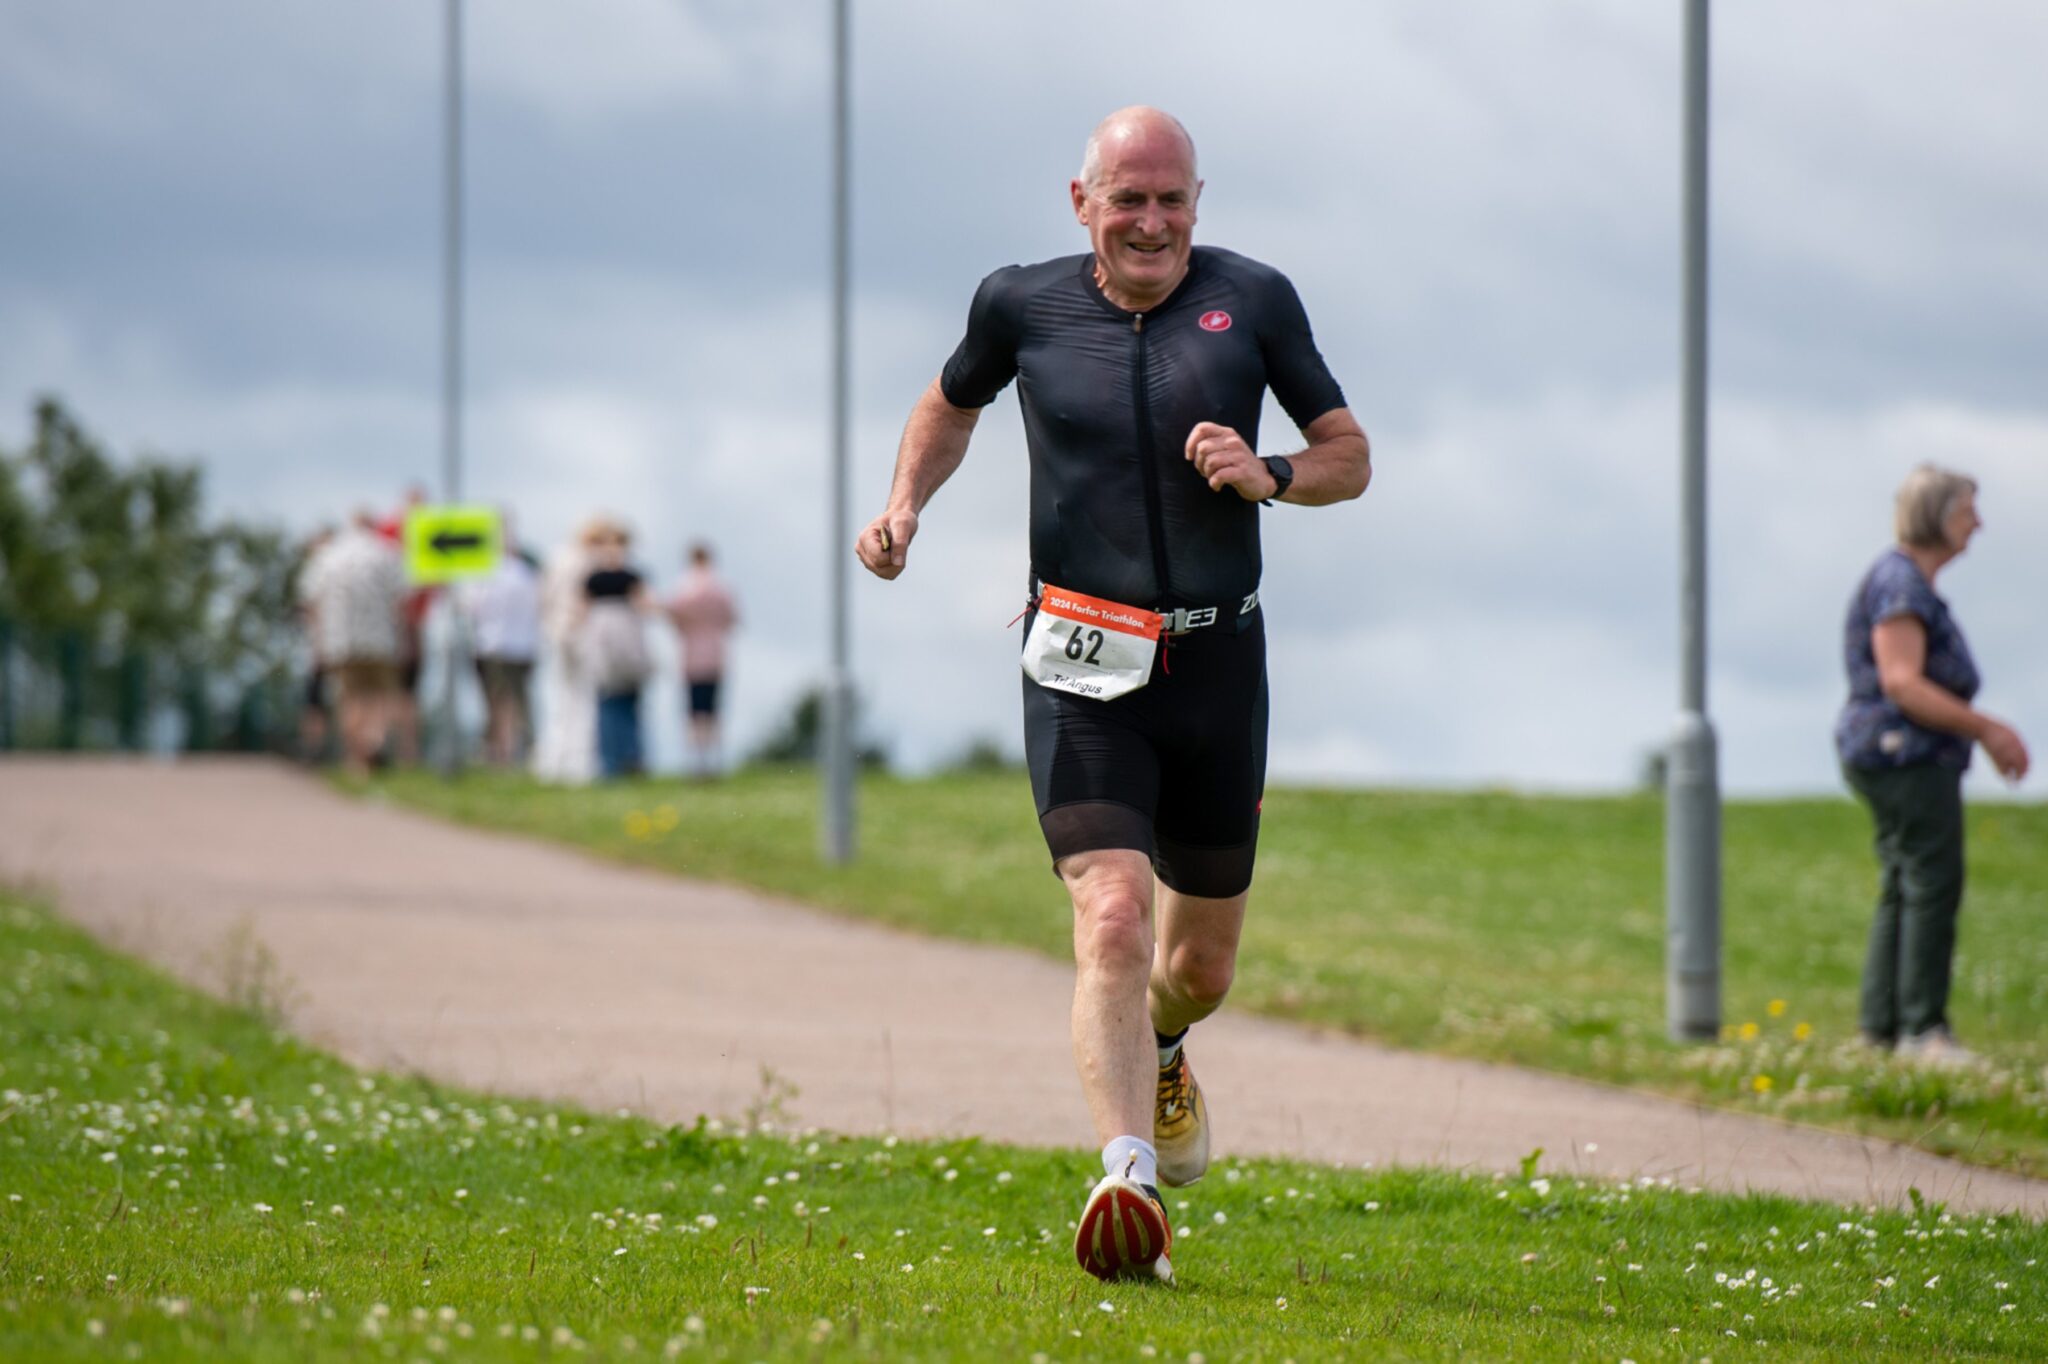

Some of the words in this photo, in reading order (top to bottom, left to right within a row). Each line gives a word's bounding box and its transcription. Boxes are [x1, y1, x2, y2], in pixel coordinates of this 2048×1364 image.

[1050, 597, 1071, 609] 2024
[1072, 602, 1100, 617] Forfar
[1101, 610, 1145, 628] Triathlon
[1185, 606, 1218, 628] E3
[1065, 626, 1104, 666] 62
[1054, 673, 1069, 685] Tri
[1067, 678, 1102, 694] Angus
